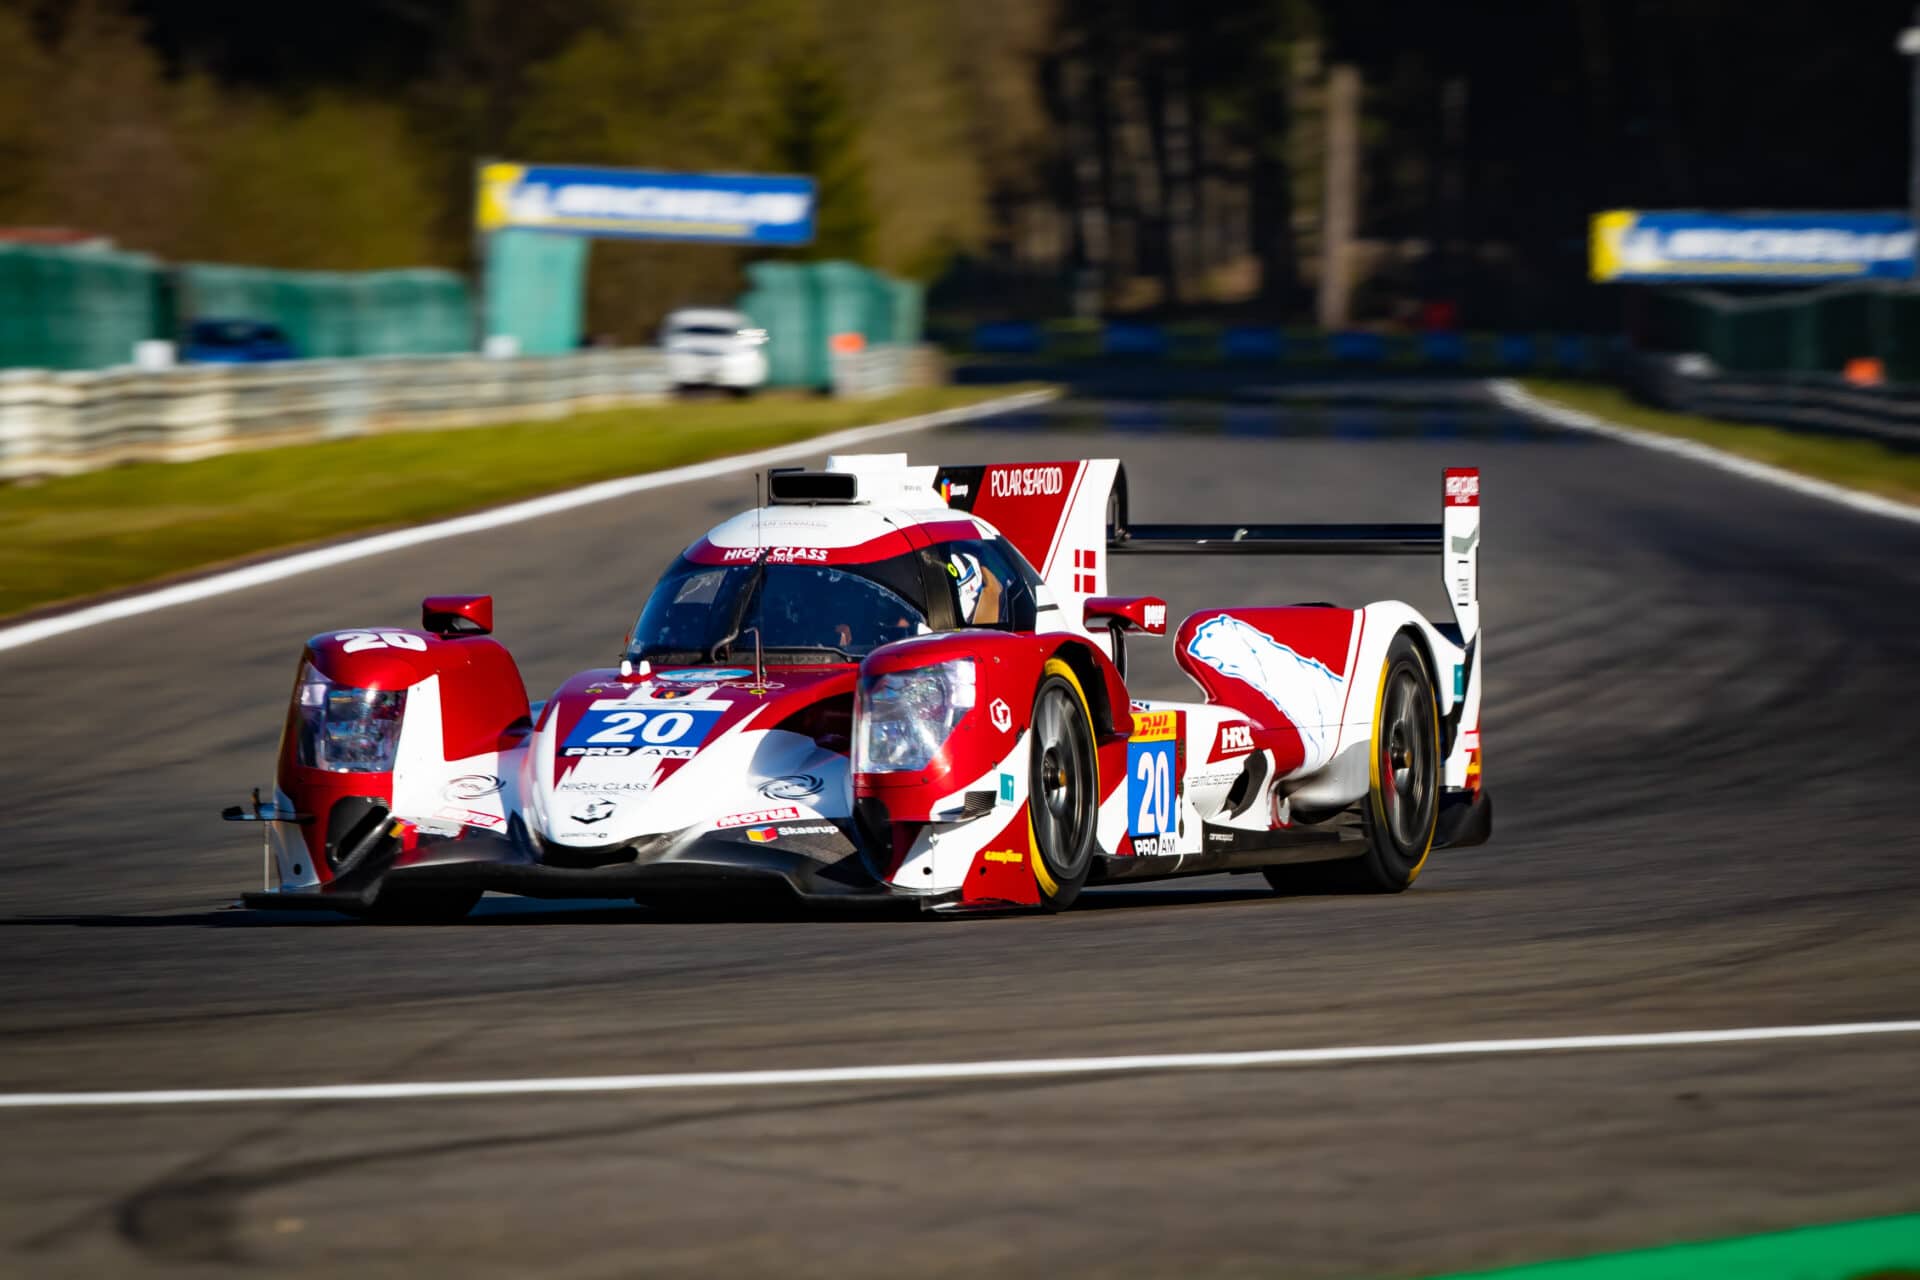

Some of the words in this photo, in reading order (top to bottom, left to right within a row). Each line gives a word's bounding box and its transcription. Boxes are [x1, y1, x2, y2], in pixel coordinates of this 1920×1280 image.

[991, 469, 1020, 497] POLAR
[1021, 467, 1062, 495] SEAFOOD
[772, 547, 828, 561] CLASS
[334, 632, 427, 653] 20
[585, 711, 694, 744] 20
[1140, 714, 1168, 737] DHL
[1221, 725, 1254, 749] HRX
[564, 747, 631, 757] PRO
[642, 748, 693, 757] AM
[602, 782, 649, 792] CLASS
[1137, 751, 1170, 833] 20
[719, 808, 797, 826] MOTUL
[778, 826, 839, 836] Skaarup
[1134, 839, 1158, 857] PRO
[1160, 839, 1177, 854] AM
